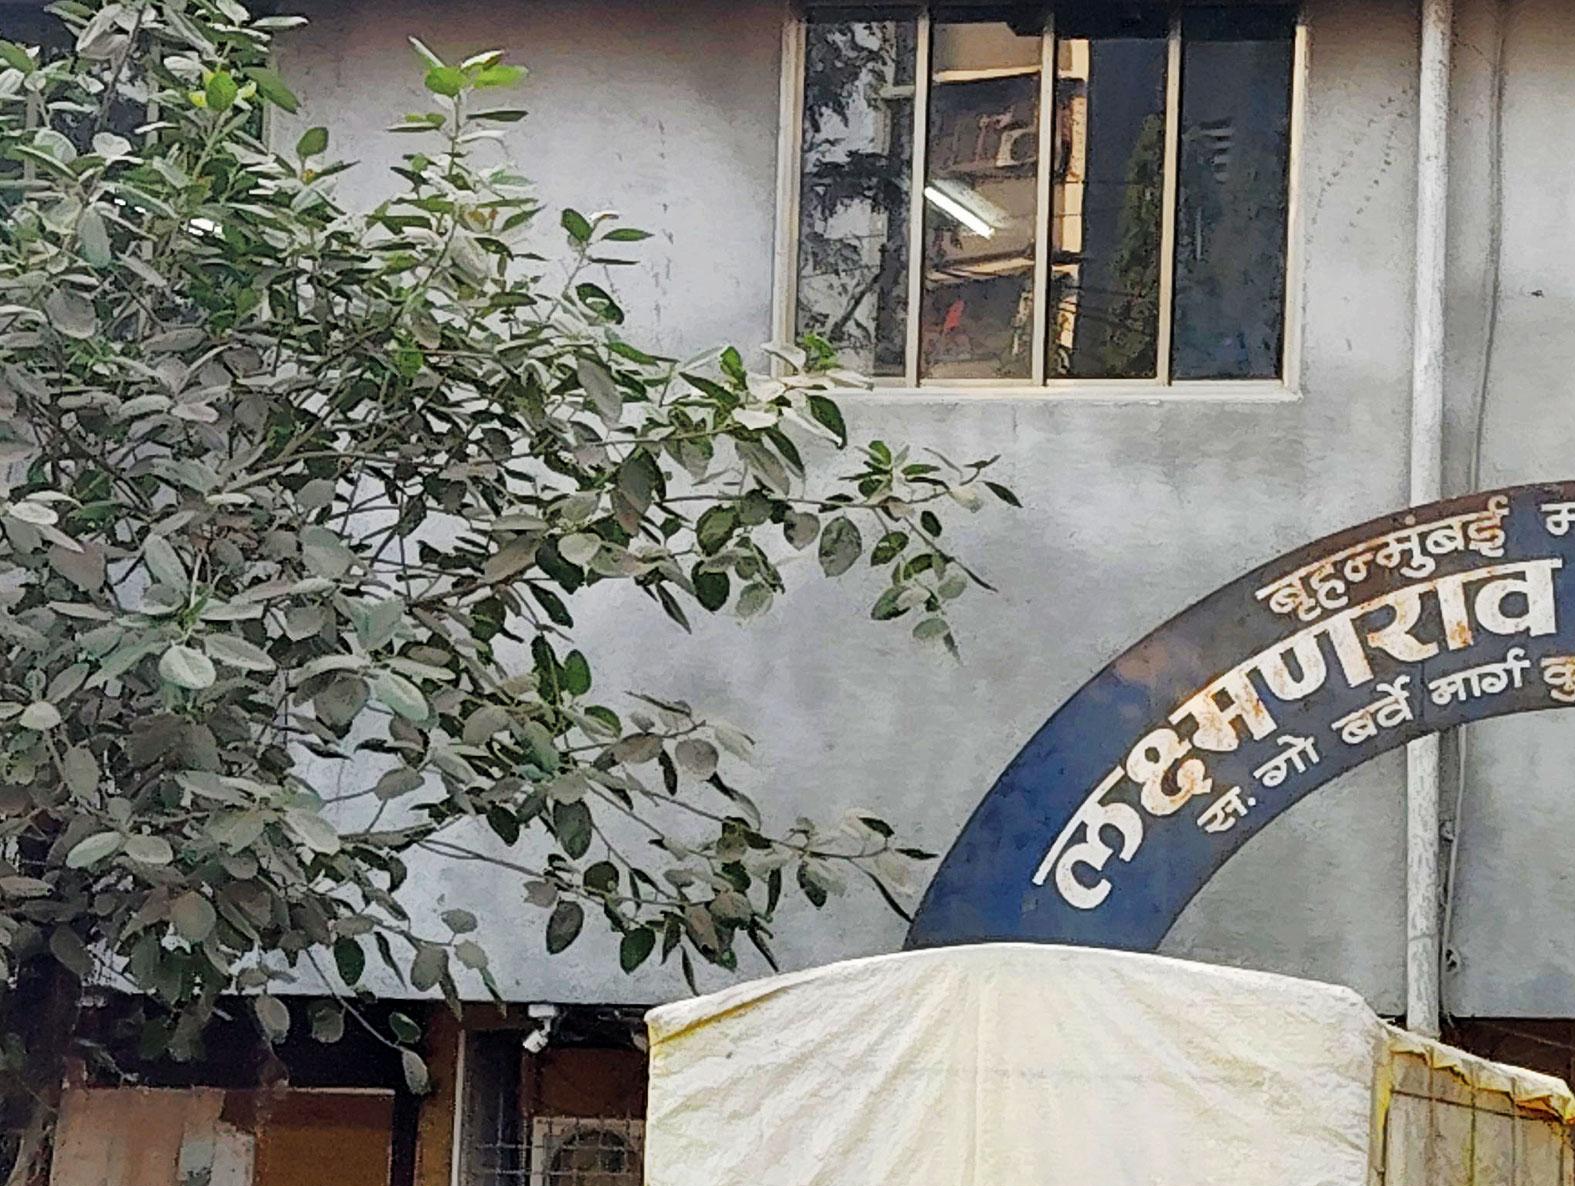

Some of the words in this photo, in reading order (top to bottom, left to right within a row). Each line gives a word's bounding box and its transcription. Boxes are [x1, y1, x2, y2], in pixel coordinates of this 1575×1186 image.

[1255, 495, 1510, 621] बृहन्मुंबई
[1032, 558, 1563, 909] लक्ष्मणराव
[1428, 648, 1531, 705] मार्ग
